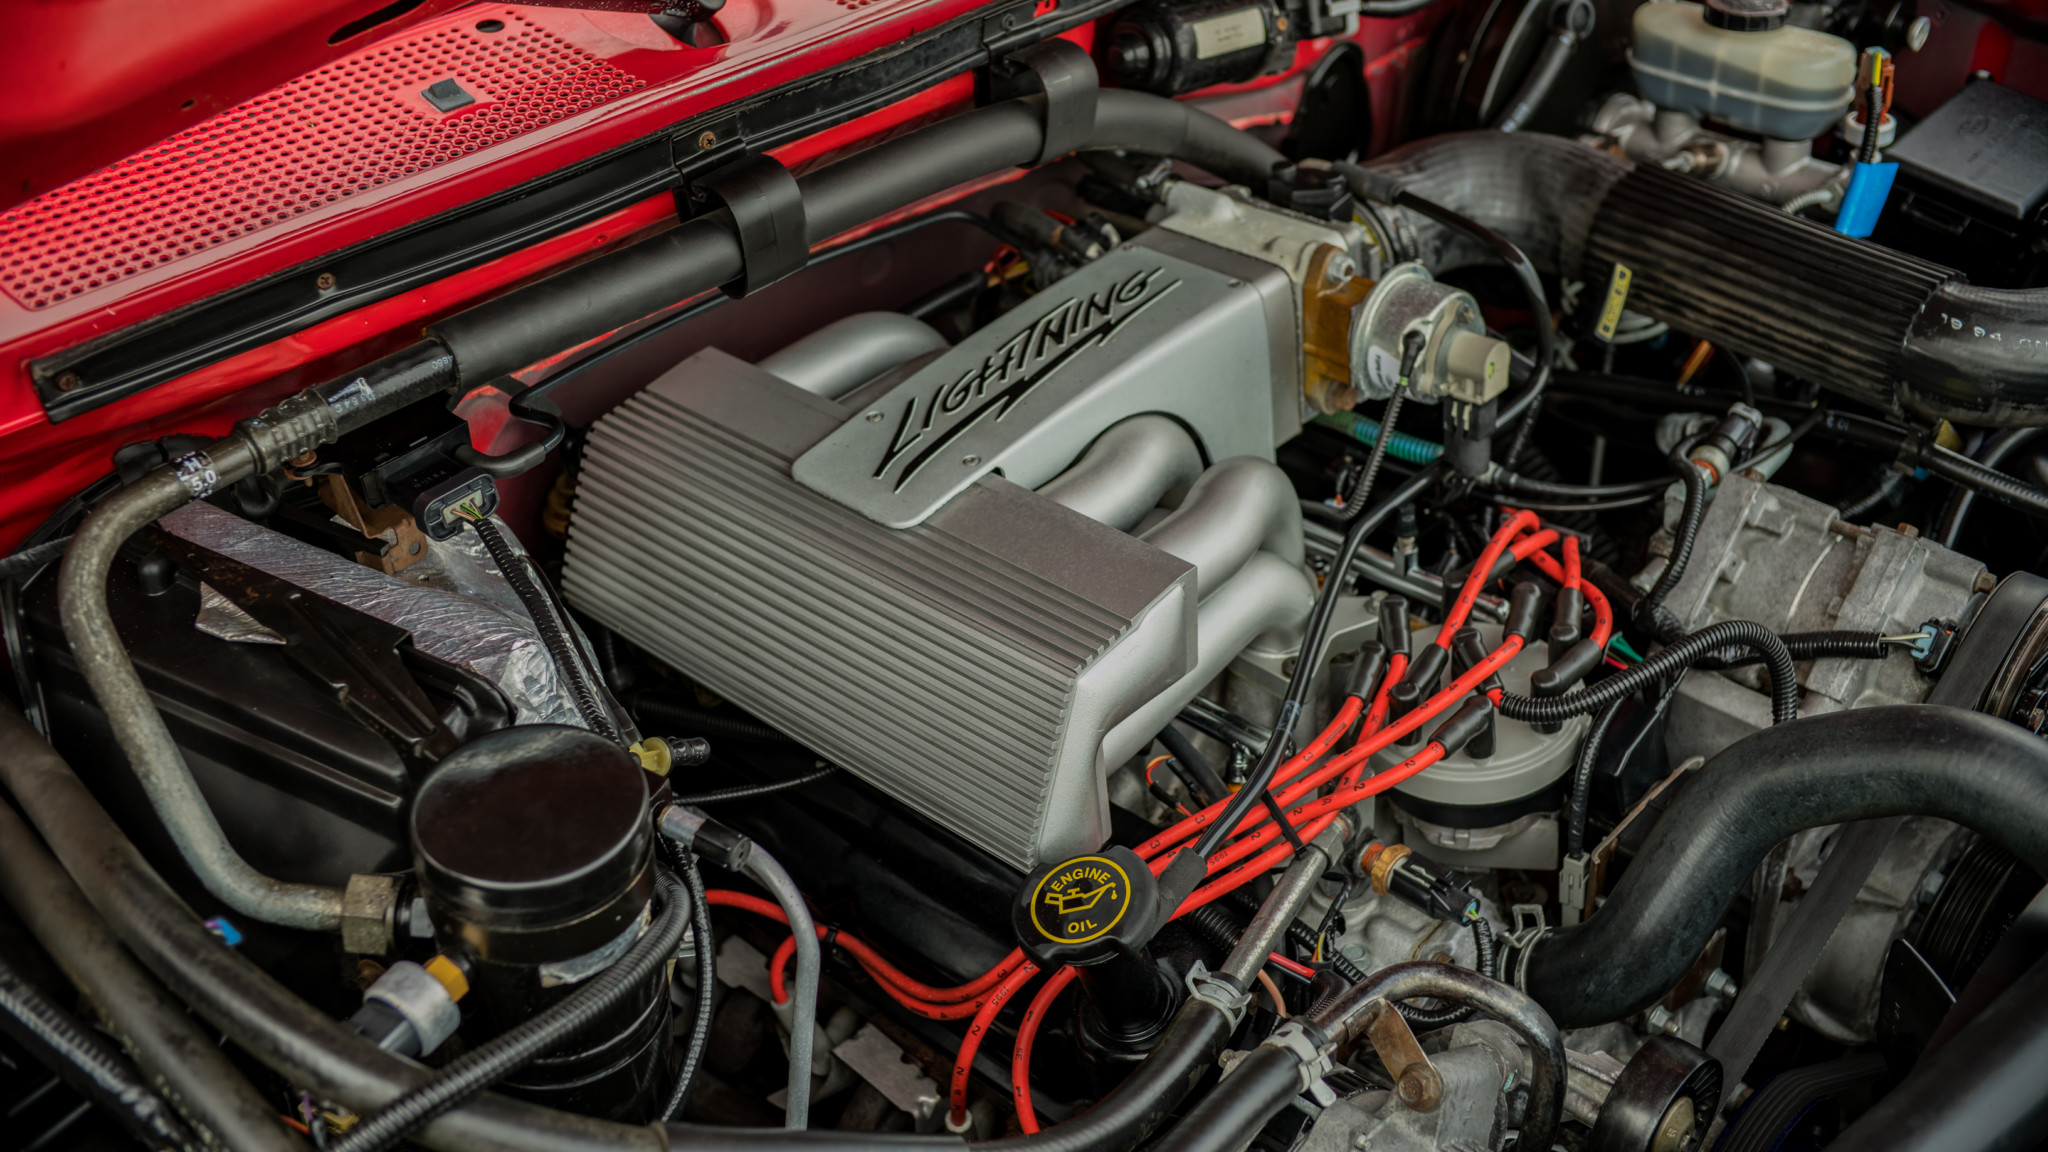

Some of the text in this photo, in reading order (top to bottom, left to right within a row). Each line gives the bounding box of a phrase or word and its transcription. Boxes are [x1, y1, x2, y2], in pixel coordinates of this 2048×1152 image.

[872, 266, 1165, 479] LIGHTNING
[191, 469, 217, 491] 5.0
[1302, 751, 1314, 762] 3
[1405, 759, 1417, 769] 2
[1353, 782, 1366, 792] 2
[1293, 807, 1303, 816] 2
[1194, 814, 1206, 824] 3
[1250, 831, 1261, 841] 2
[1150, 840, 1160, 850] 3
[1208, 851, 1228, 866] 1995
[1050, 867, 1111, 892] ENGINE
[1067, 919, 1097, 934] OIL
[1023, 962, 1035, 973] 2
[997, 969, 1007, 978] 3
[991, 986, 1010, 1006] 1995
[971, 1025, 981, 1036] 2
[956, 1066, 965, 1075] 2
[1015, 1086, 1022, 1097] 1
